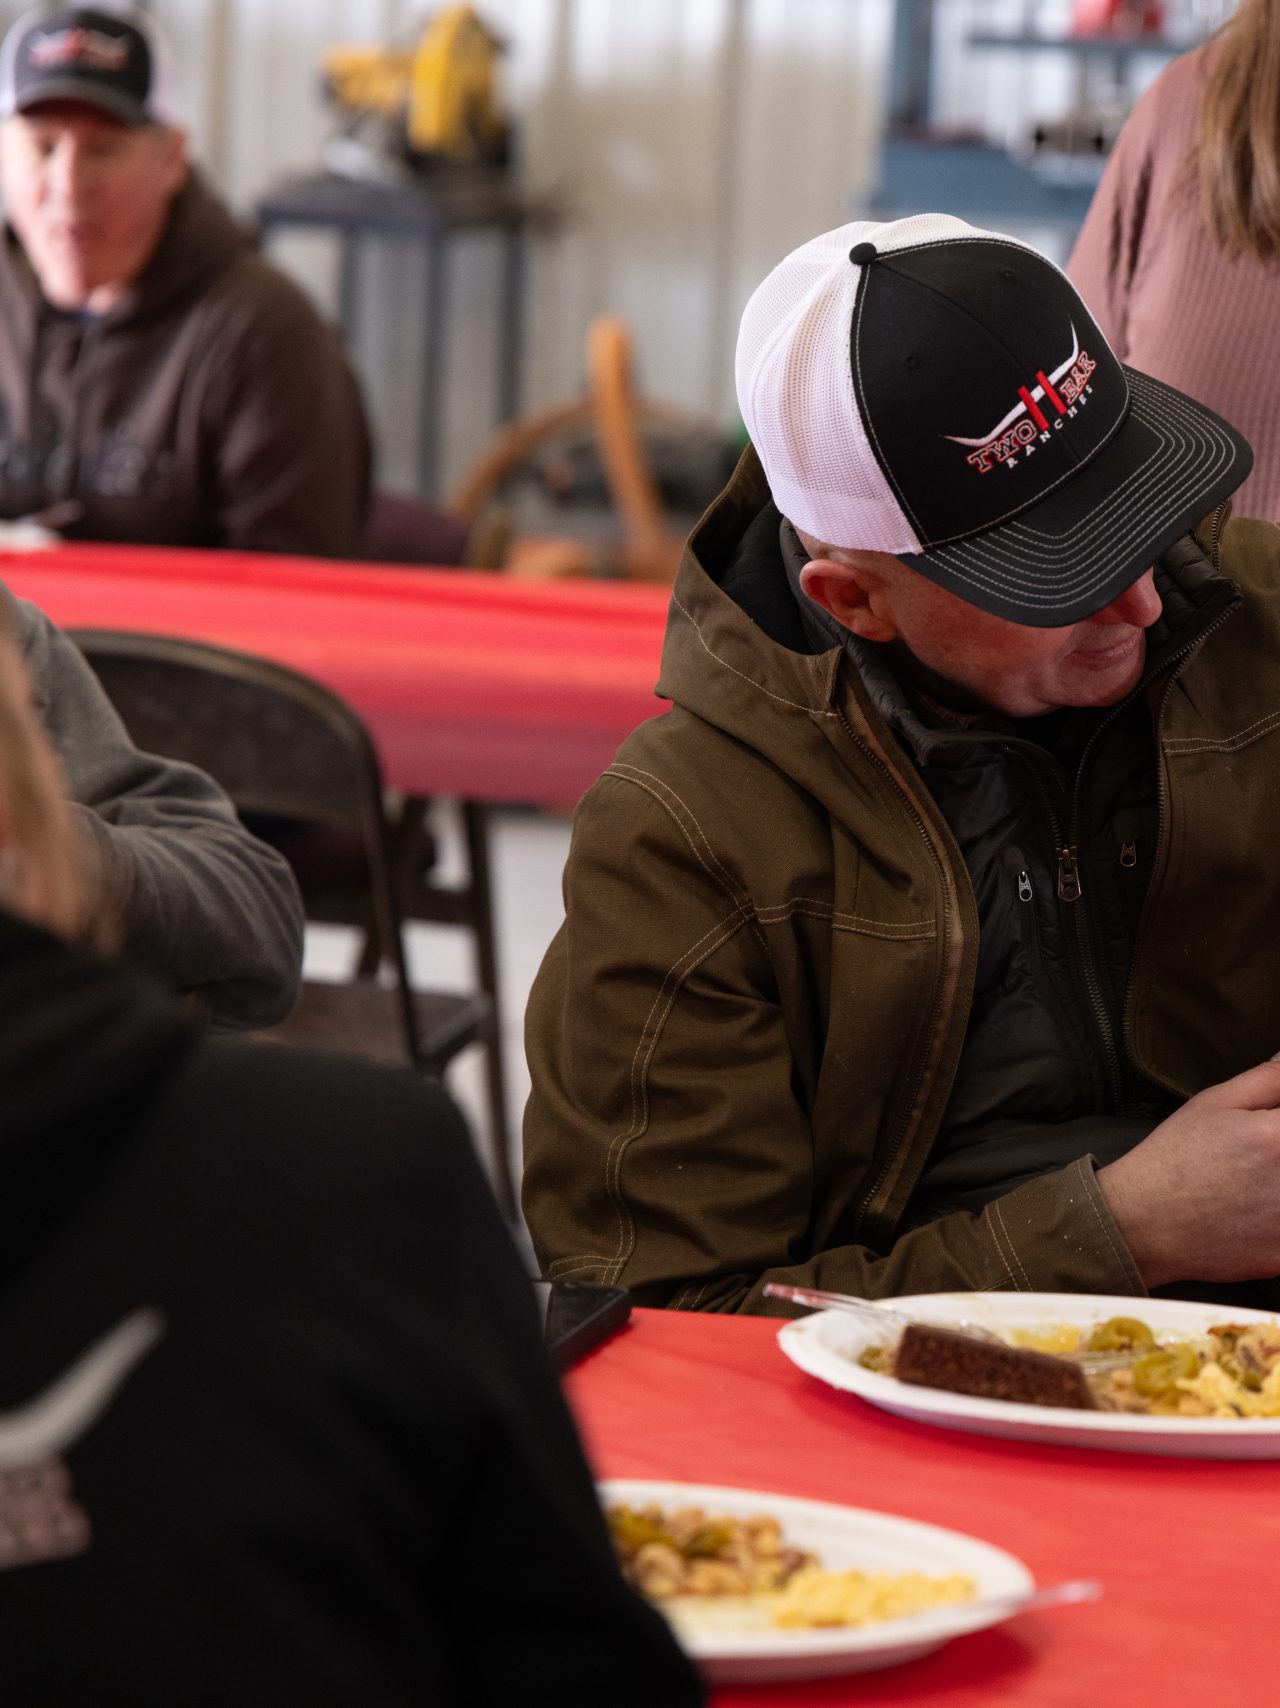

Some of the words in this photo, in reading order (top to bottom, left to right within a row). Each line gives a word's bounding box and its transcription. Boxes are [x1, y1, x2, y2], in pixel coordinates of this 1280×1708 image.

[967, 419, 1039, 473] TWO
[1059, 350, 1097, 405] BAR
[1006, 385, 1093, 469] RANCHES
